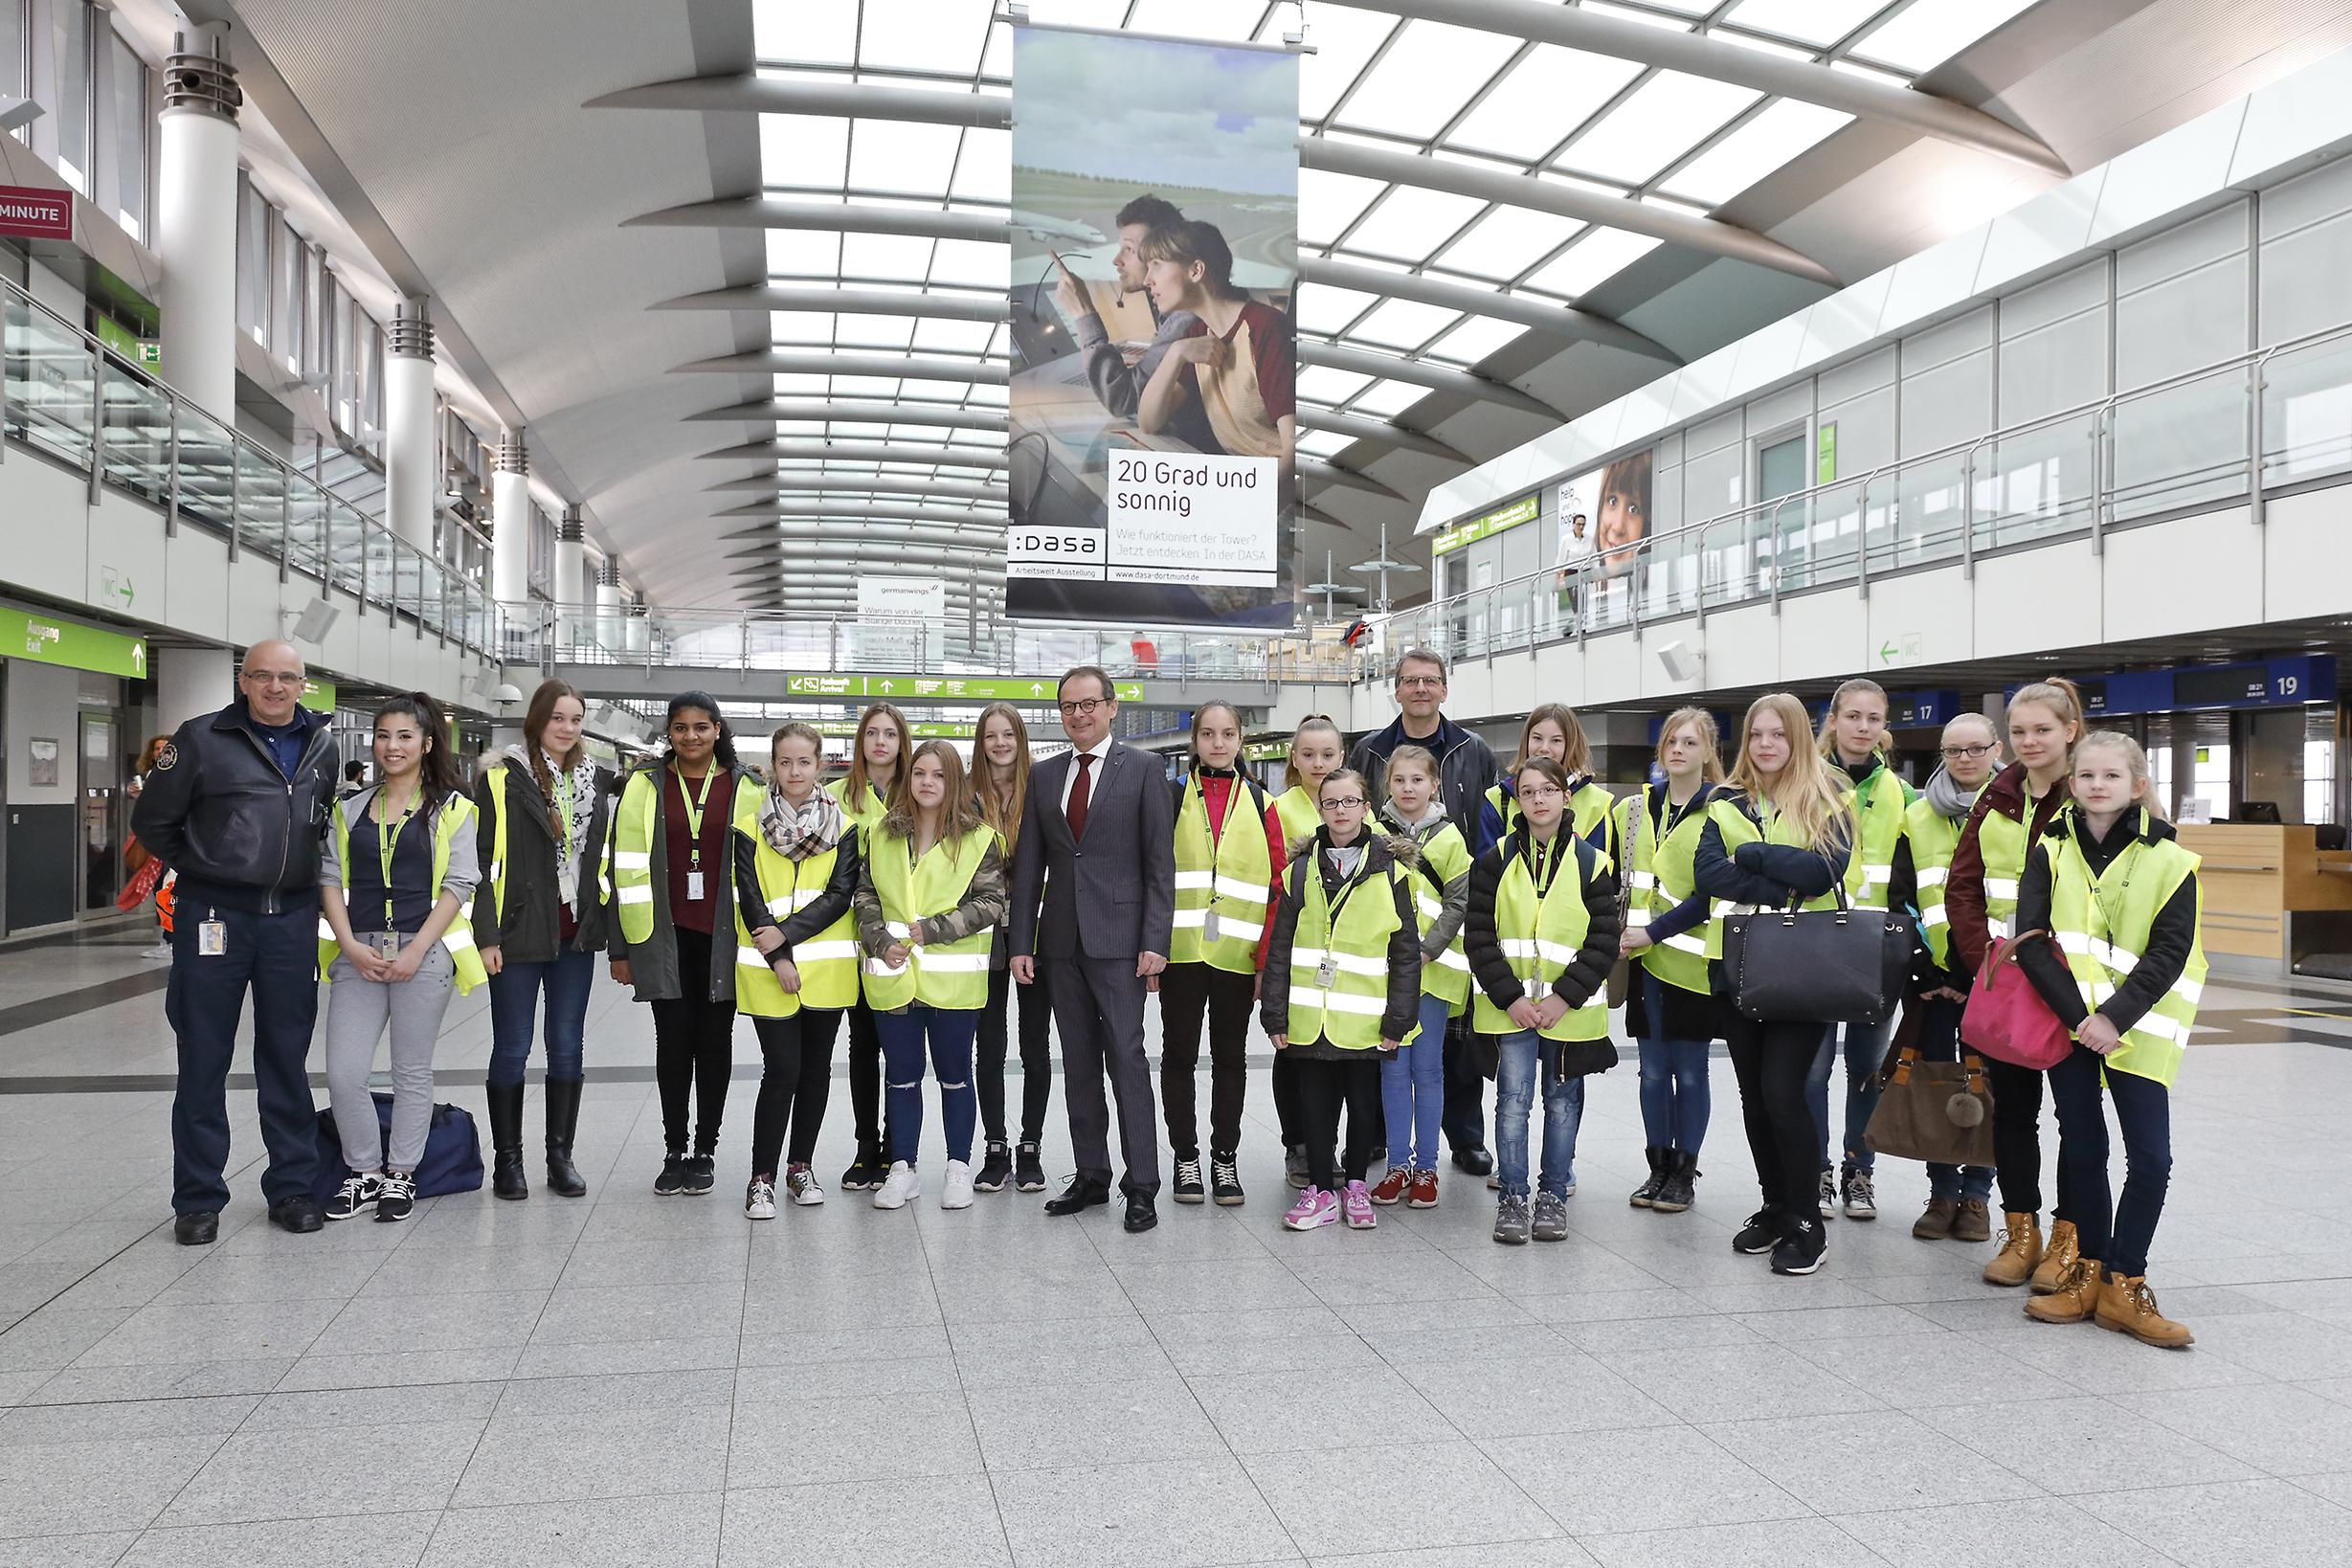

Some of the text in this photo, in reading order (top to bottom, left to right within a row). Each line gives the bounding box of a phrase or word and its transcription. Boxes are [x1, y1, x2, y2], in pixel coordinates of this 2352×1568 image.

[0, 204, 58, 221] MINUTE
[1118, 459, 1256, 488] 20 Grad und
[1117, 490, 1191, 518] sonnig
[1116, 527, 1257, 545] Wie funktioniert der Tower?
[1116, 544, 1144, 557] Jetzt
[1204, 549, 1215, 560] In
[1219, 549, 1235, 561] der
[1015, 567, 1096, 578] Arbeitswelt Ausstellung
[1115, 571, 1199, 582] www.dasa-dortmund.de
[28, 619, 59, 642] Ausgang
[26, 638, 42, 654] Exit
[2277, 676, 2297, 696] 19
[1919, 706, 1932, 720] 17
[383, 938, 390, 947] B
[1319, 962, 1327, 971] B
